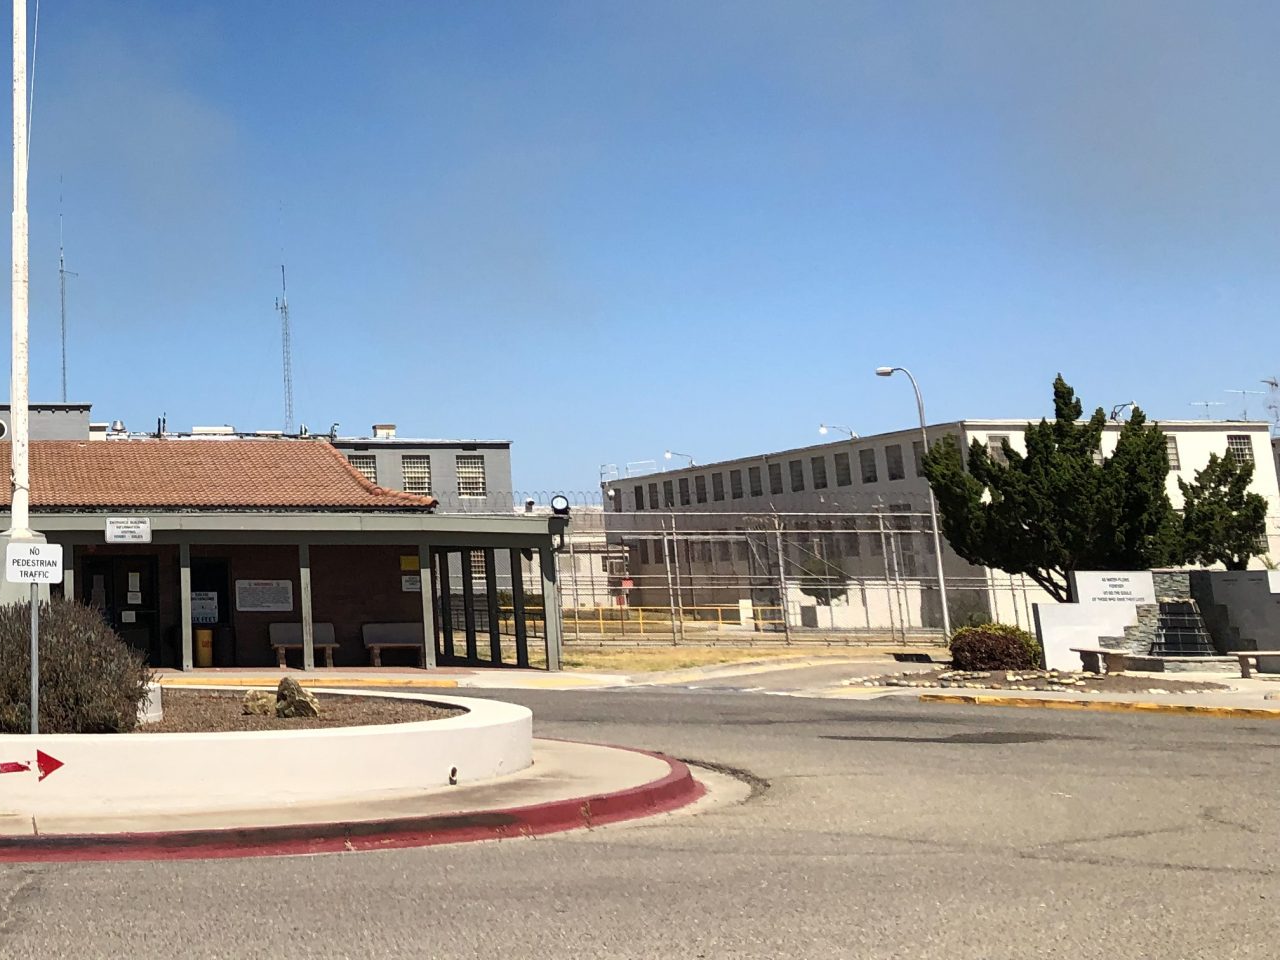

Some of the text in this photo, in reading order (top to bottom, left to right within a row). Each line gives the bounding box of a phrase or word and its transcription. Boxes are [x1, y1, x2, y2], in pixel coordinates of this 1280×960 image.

[29, 547, 40, 556] NO
[12, 558, 57, 567] PEDESTRIAN
[20, 570, 50, 579] TRAFFIC
